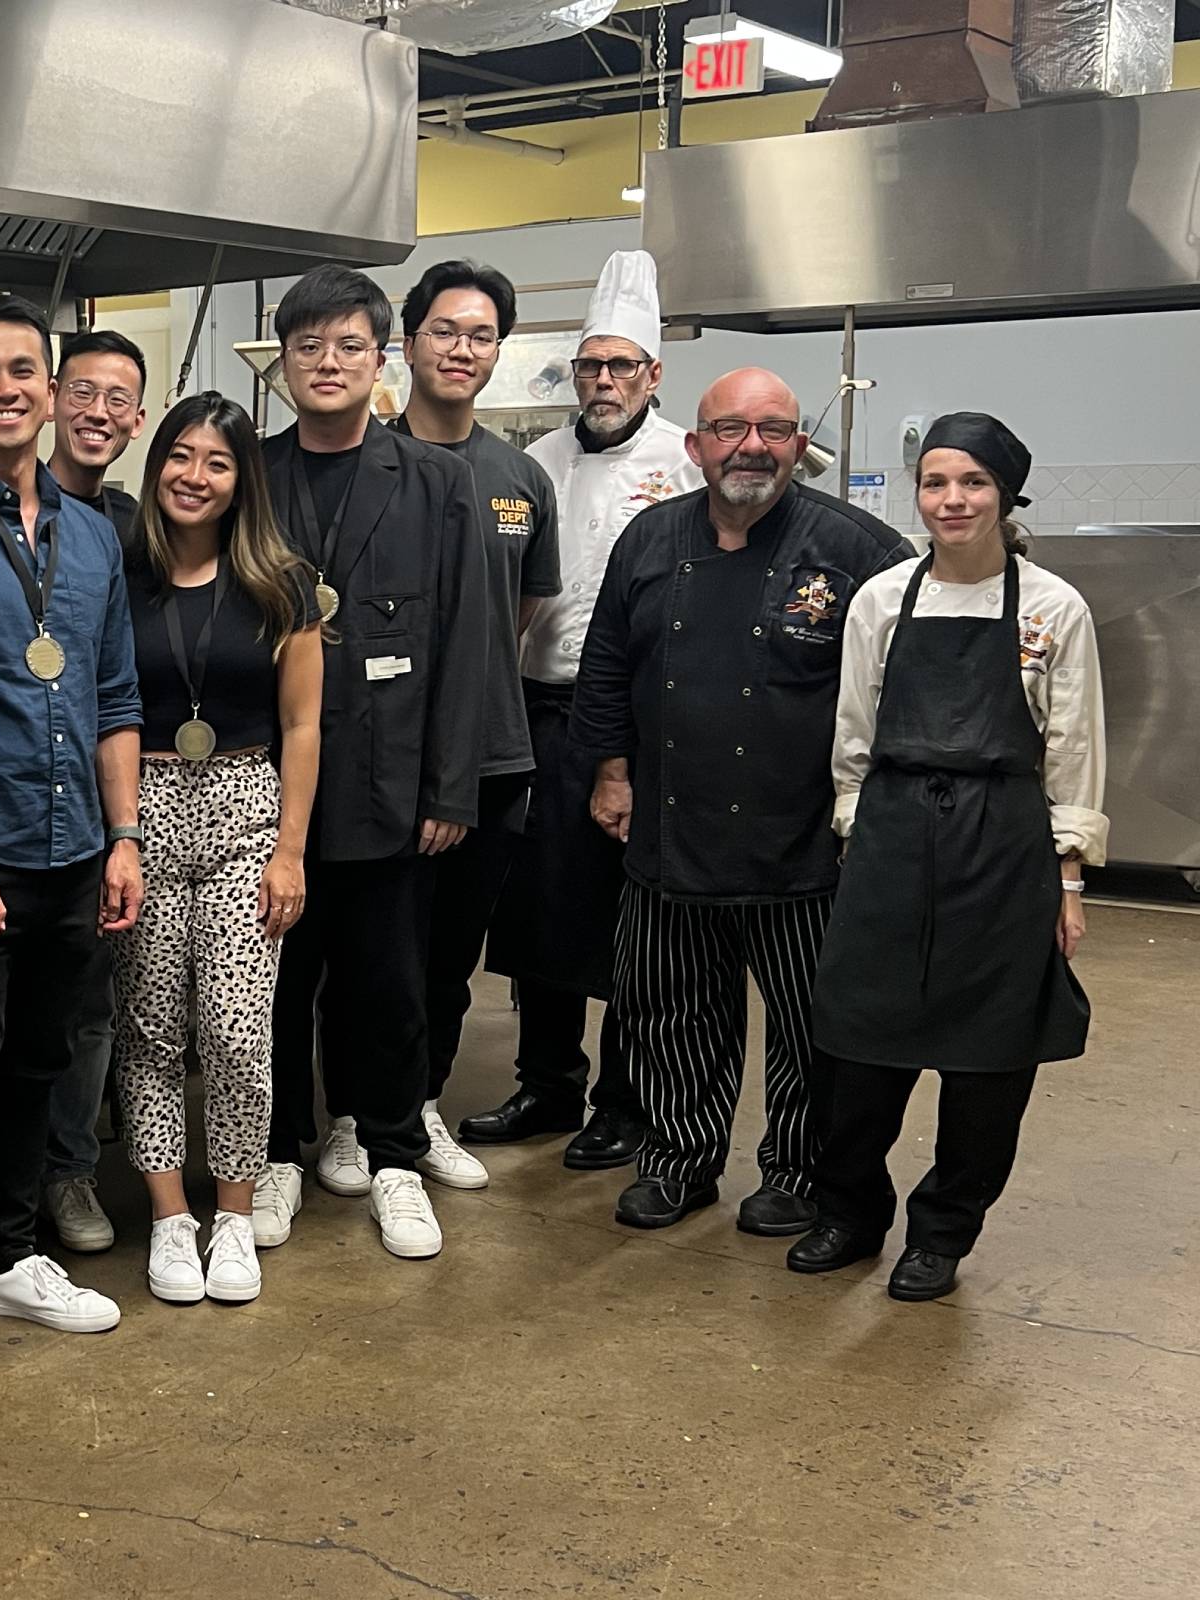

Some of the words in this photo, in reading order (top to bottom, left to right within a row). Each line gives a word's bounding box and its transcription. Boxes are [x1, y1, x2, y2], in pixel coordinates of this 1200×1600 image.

[696, 38, 749, 91] EXIT
[491, 498, 530, 513] GALLERY
[499, 511, 528, 524] DEPT.
